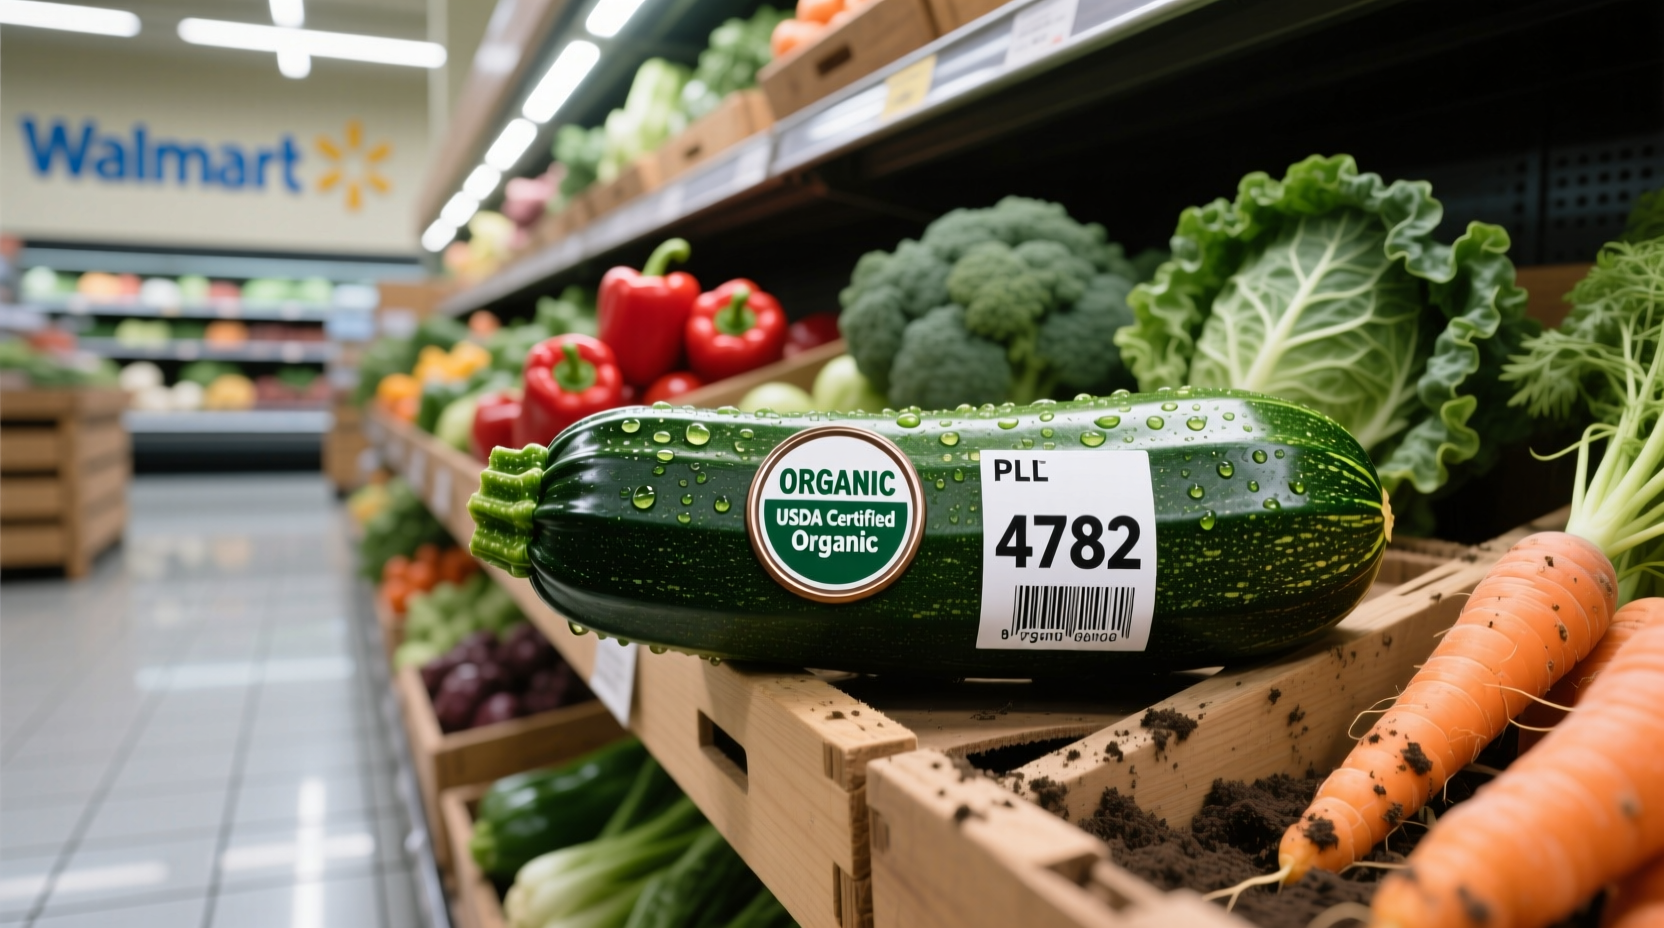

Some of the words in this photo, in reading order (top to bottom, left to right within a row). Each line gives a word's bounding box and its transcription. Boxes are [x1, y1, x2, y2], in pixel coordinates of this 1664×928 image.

[20, 116, 303, 193] Walmart
[779, 467, 896, 496] ORGANIC
[776, 508, 823, 527] USDA
[826, 509, 896, 528] Certified
[791, 529, 879, 558] Organic
[995, 514, 1142, 570] 4782
